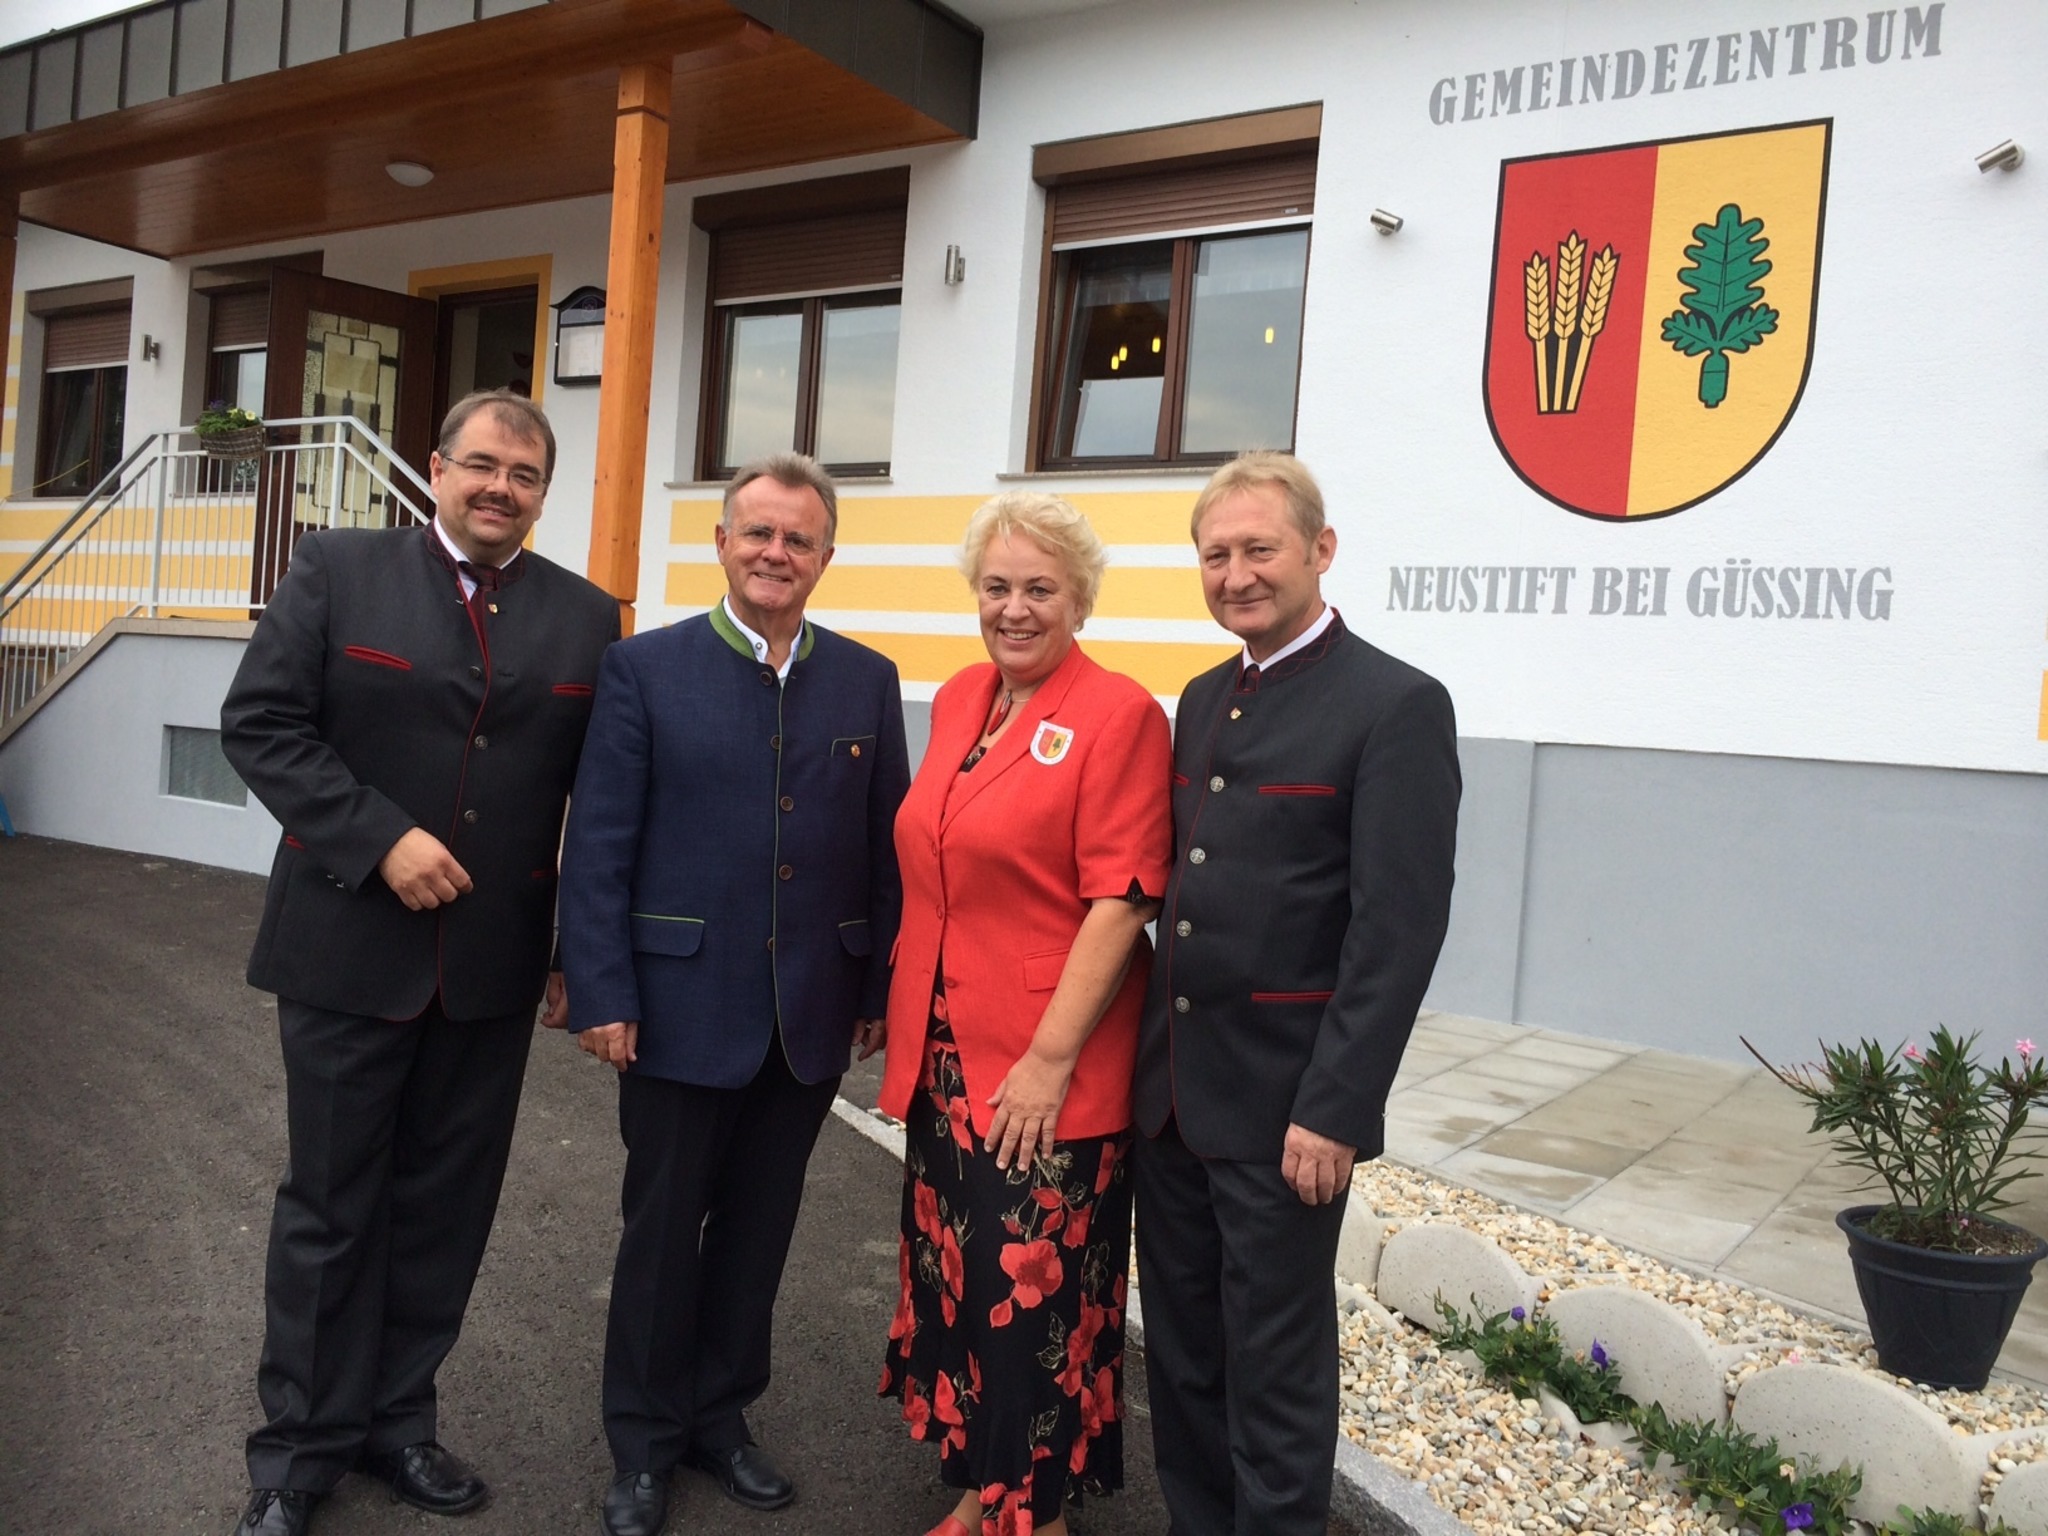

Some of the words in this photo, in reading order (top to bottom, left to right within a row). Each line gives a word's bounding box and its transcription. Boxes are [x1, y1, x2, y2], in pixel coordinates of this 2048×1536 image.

[1430, 3, 1945, 124] GEMEINDEZENTRUM
[1386, 566, 1576, 613] NEUSTIFT
[1589, 567, 1670, 616] BEI
[1686, 558, 1894, 620] GÜSSING
